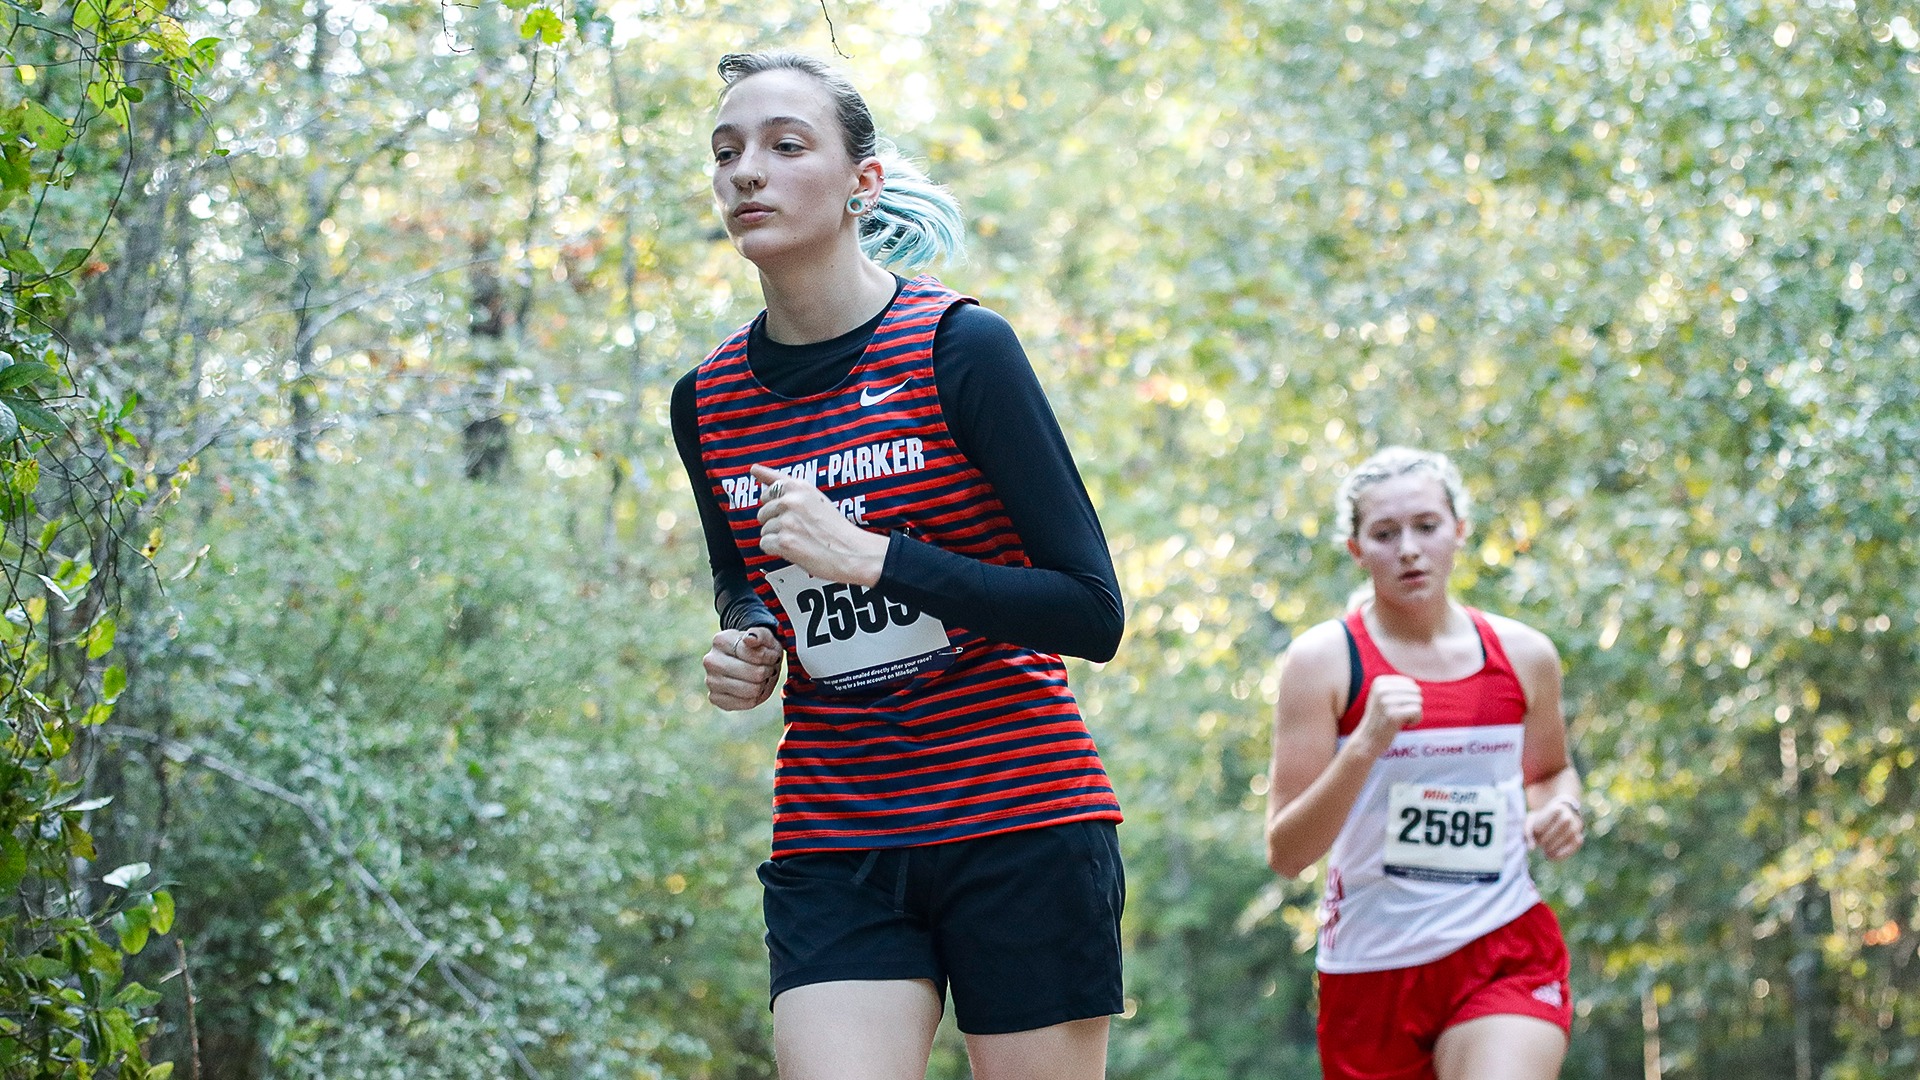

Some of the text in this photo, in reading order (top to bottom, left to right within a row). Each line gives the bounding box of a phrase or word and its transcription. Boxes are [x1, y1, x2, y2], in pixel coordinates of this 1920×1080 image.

[721, 437, 926, 510] BREON-PARKER
[852, 671, 871, 680] emailed
[871, 666, 890, 676] directly
[890, 663, 904, 671] after
[904, 660, 917, 668] your
[917, 654, 933, 664] race?
[866, 675, 887, 685] account
[894, 666, 919, 677] MileSplit
[1398, 807, 1495, 848] 2595
